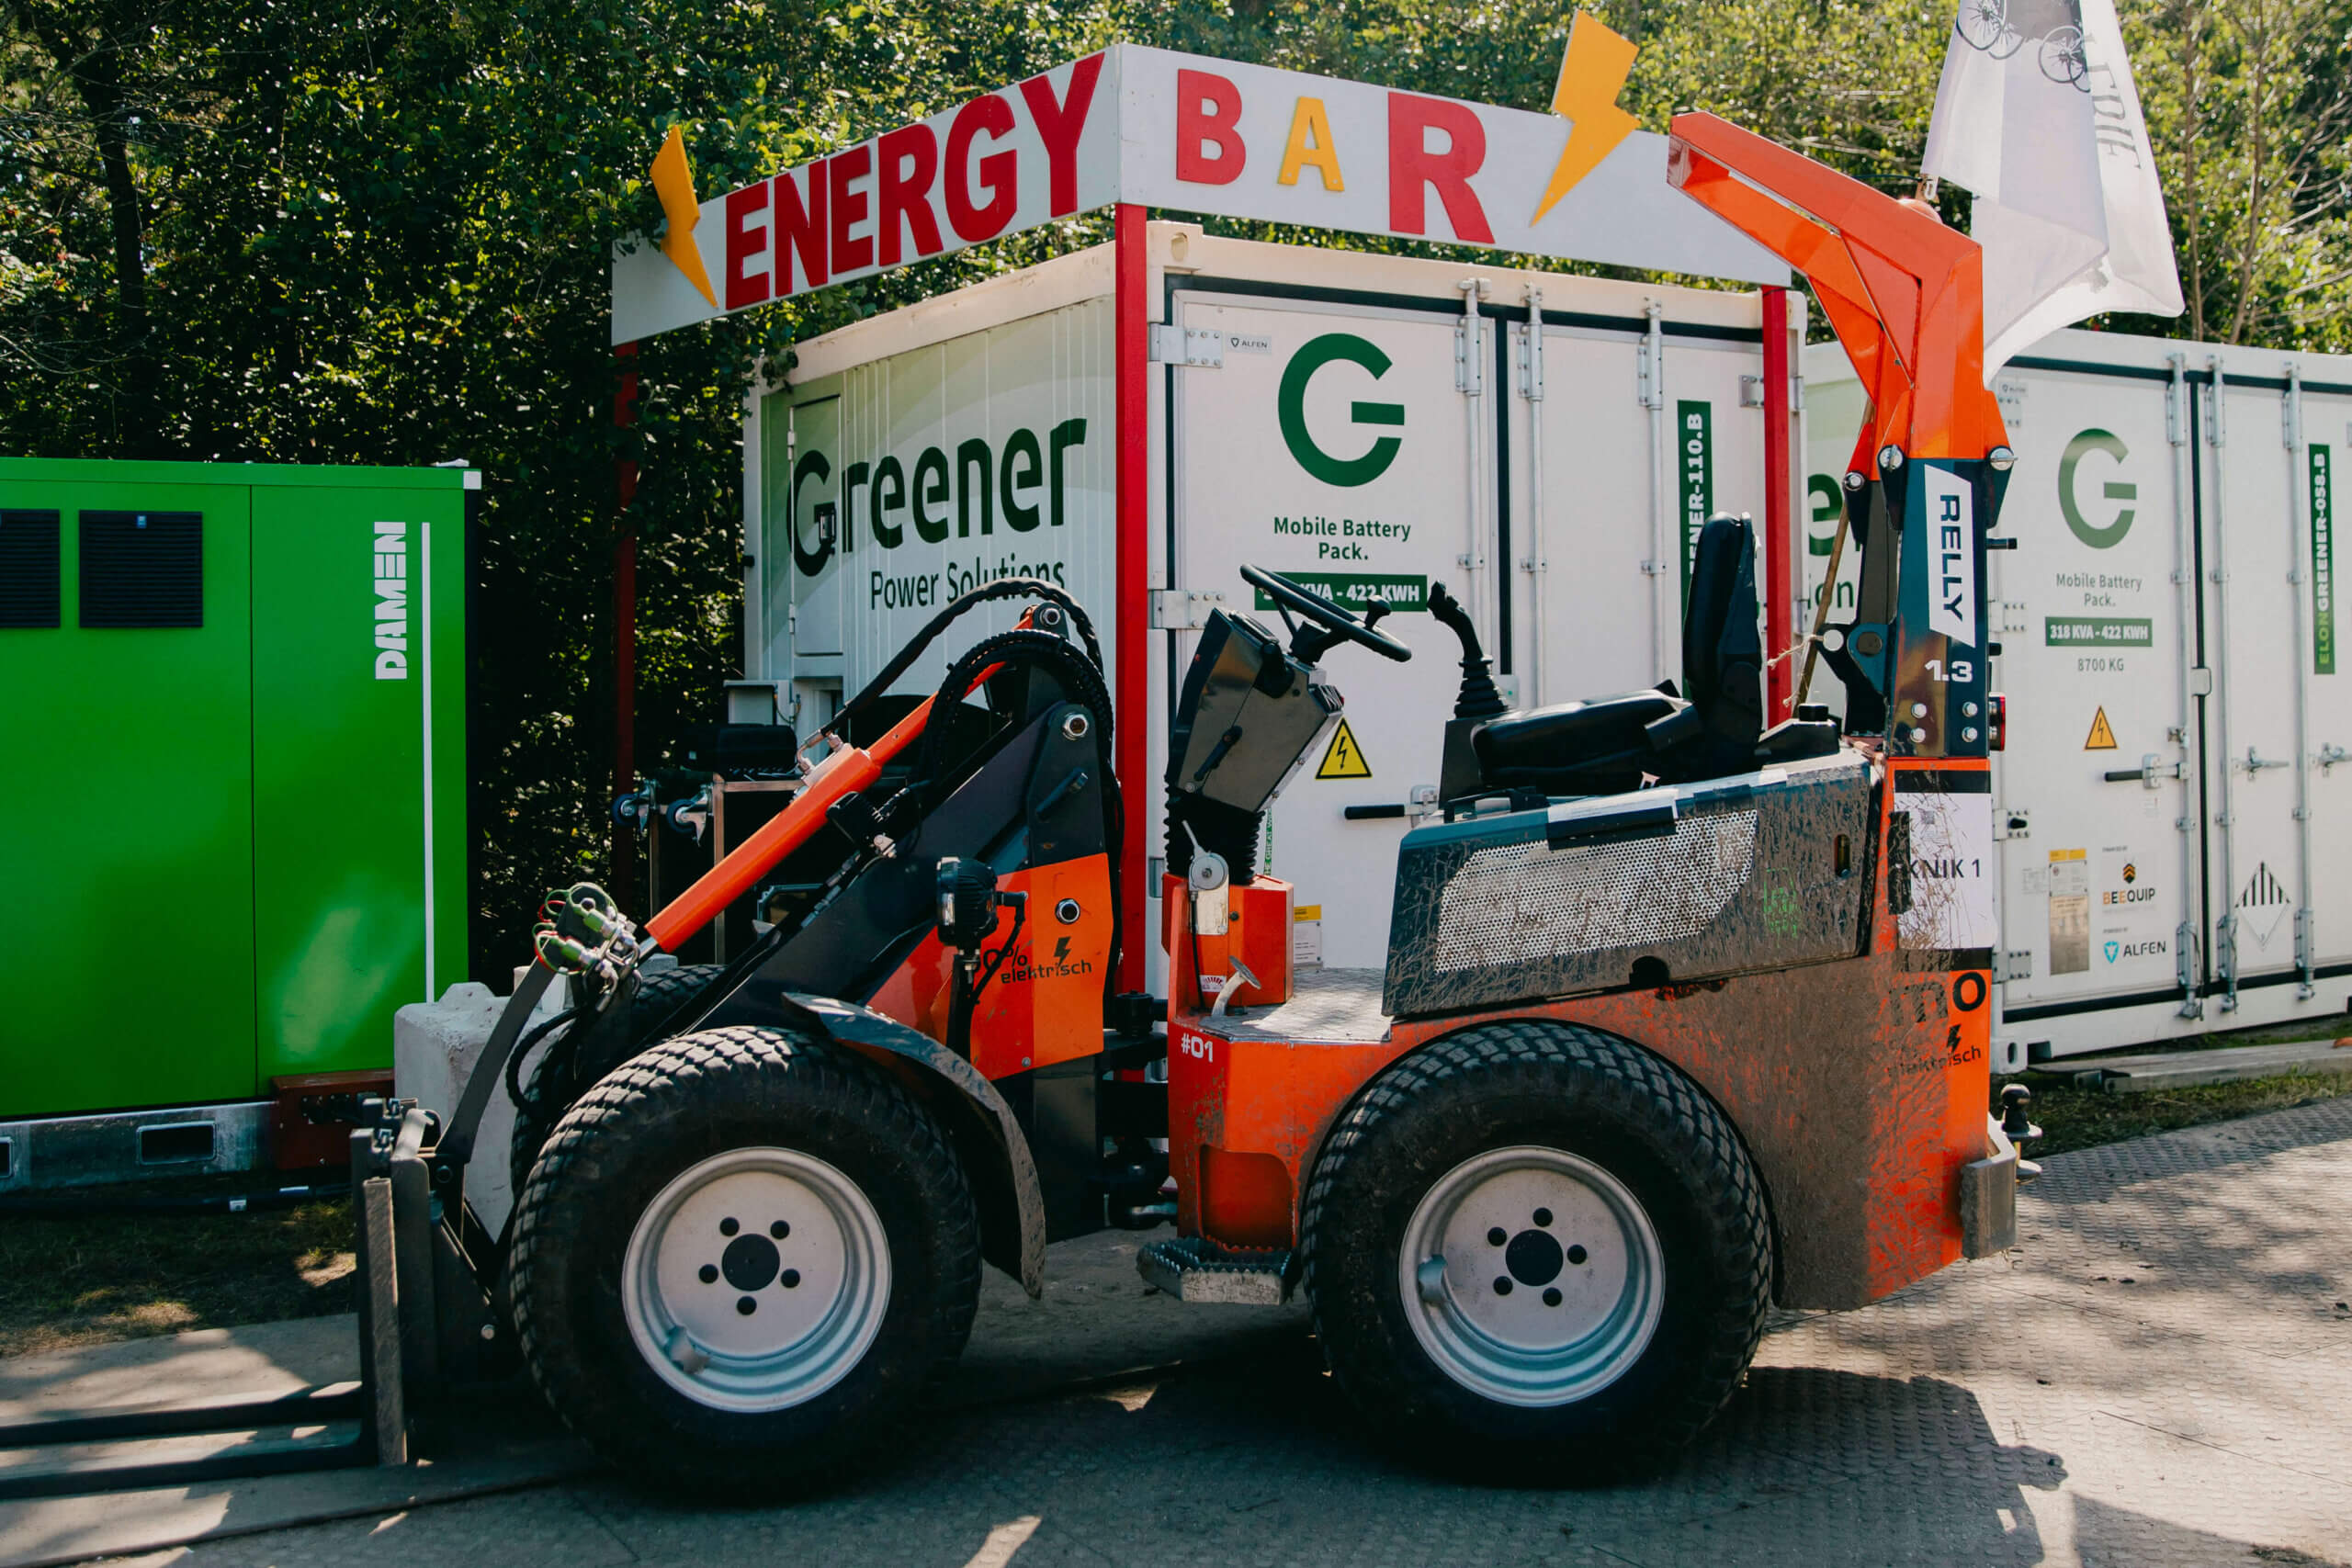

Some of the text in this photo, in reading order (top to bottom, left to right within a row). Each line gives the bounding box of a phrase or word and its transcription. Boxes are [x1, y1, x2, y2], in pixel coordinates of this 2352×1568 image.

[725, 51, 1496, 310] ENERGY BAR
[1278, 333, 1406, 488] G
[786, 418, 1087, 577] Greener
[1273, 516, 1412, 542] Mobile Battery
[1318, 542, 1369, 560] Pack.
[1939, 494, 1962, 622] RELLY
[871, 572, 939, 611] Power
[1381, 584, 1419, 603] KWH
[2056, 572, 2143, 592] Mobile Battery
[374, 521, 408, 680] DAMEN
[2084, 592, 2117, 607] Pack.
[2050, 625, 2071, 639] 318
[2072, 625, 2095, 639] KVA
[2101, 626, 2122, 640] 422
[2122, 626, 2149, 640] KWH
[1925, 660, 1973, 682] 1.3
[2077, 658, 2125, 671] 8700 KG
[2102, 887, 2156, 906] BEEQUIP
[2122, 941, 2166, 957] ALFEN
[1001, 959, 1092, 984] elektrisch
[1181, 1032, 1214, 1063] #01
